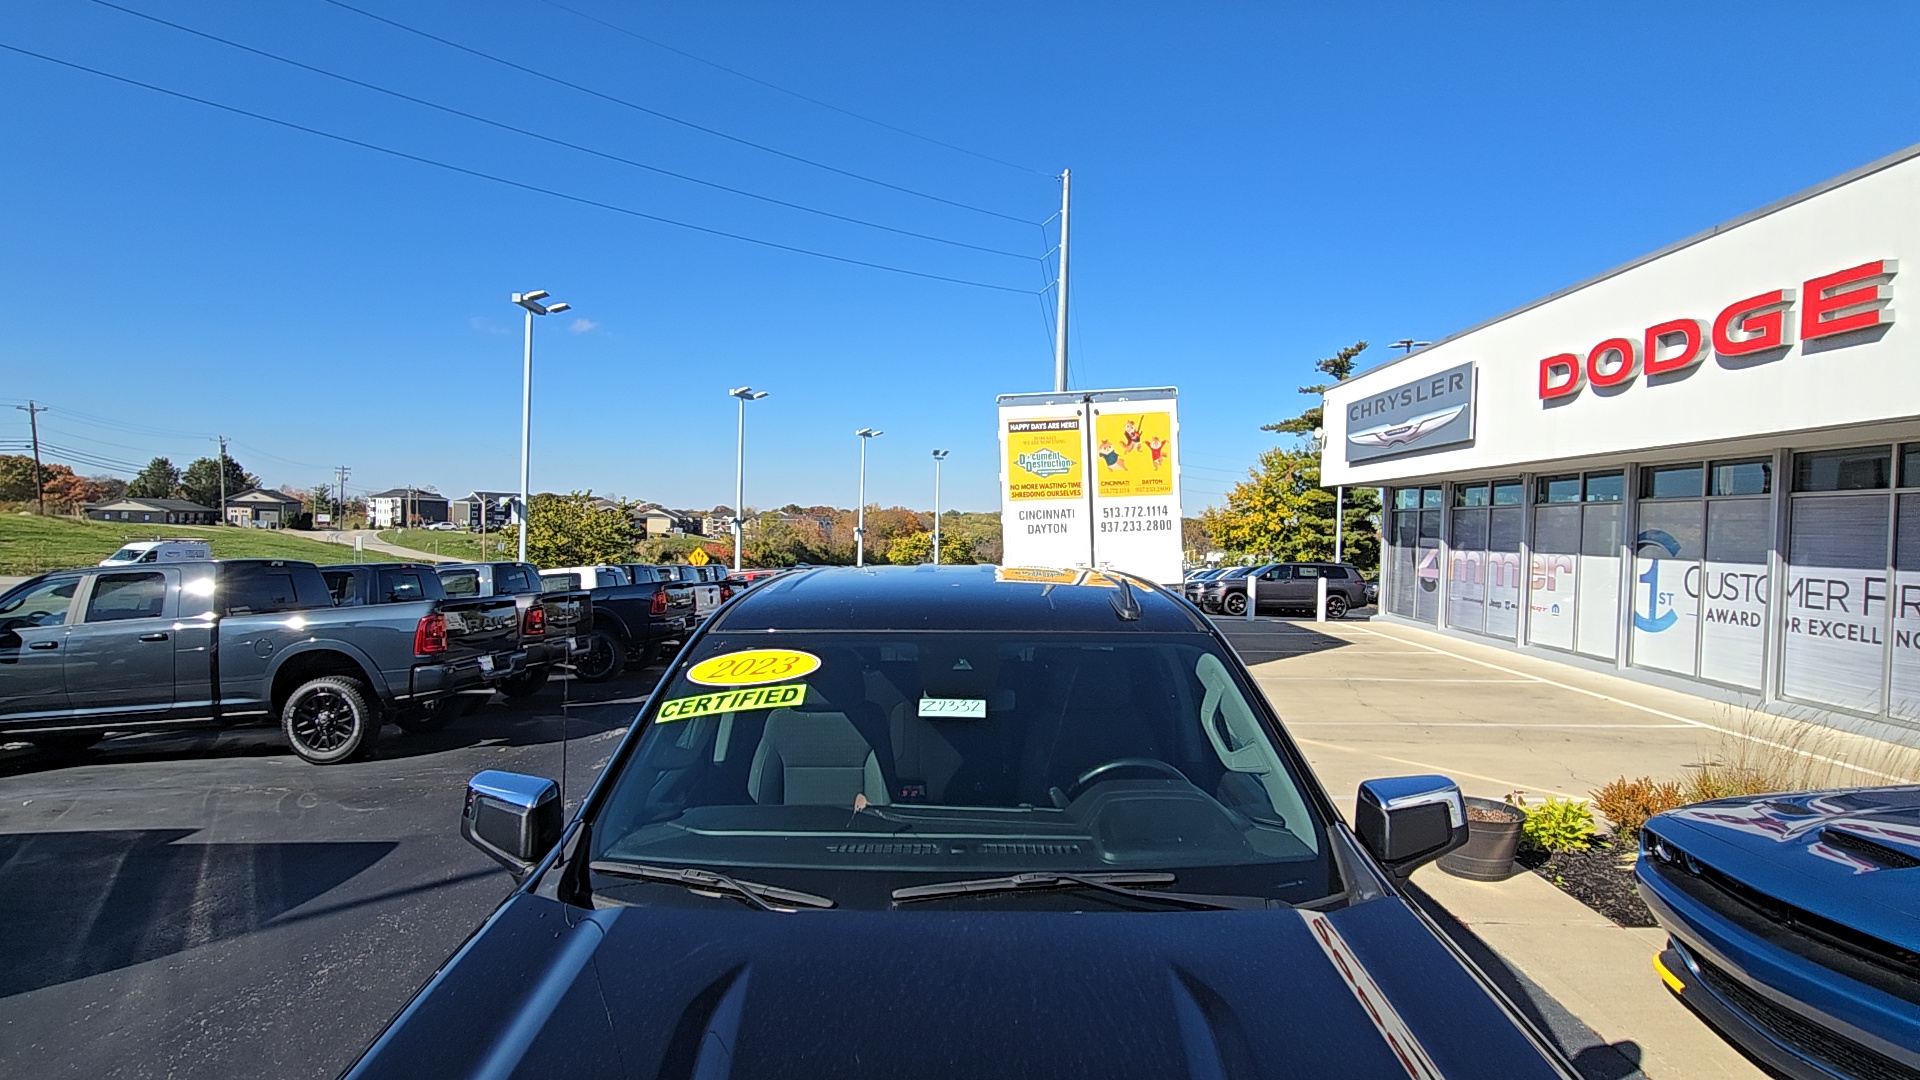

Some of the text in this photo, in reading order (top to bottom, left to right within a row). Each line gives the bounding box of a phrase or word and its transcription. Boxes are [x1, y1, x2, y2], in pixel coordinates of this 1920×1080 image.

[1539, 259, 1898, 400] DODGE
[1349, 372, 1464, 421] CHRYSLER
[1010, 423, 1030, 431] HAPPY
[1031, 422, 1047, 430] DAYS
[1061, 421, 1078, 429] HERE!
[1026, 460, 1071, 472] Destruction
[1039, 482, 1067, 490] WASTING
[1018, 505, 1168, 521] CINCINNATI 513.772.1114
[1027, 519, 1172, 535] DAYTON 937.233.2800
[1705, 608, 1761, 628] AWARD
[707, 656, 801, 679] 2023
[660, 687, 799, 719] CERTIFIED
